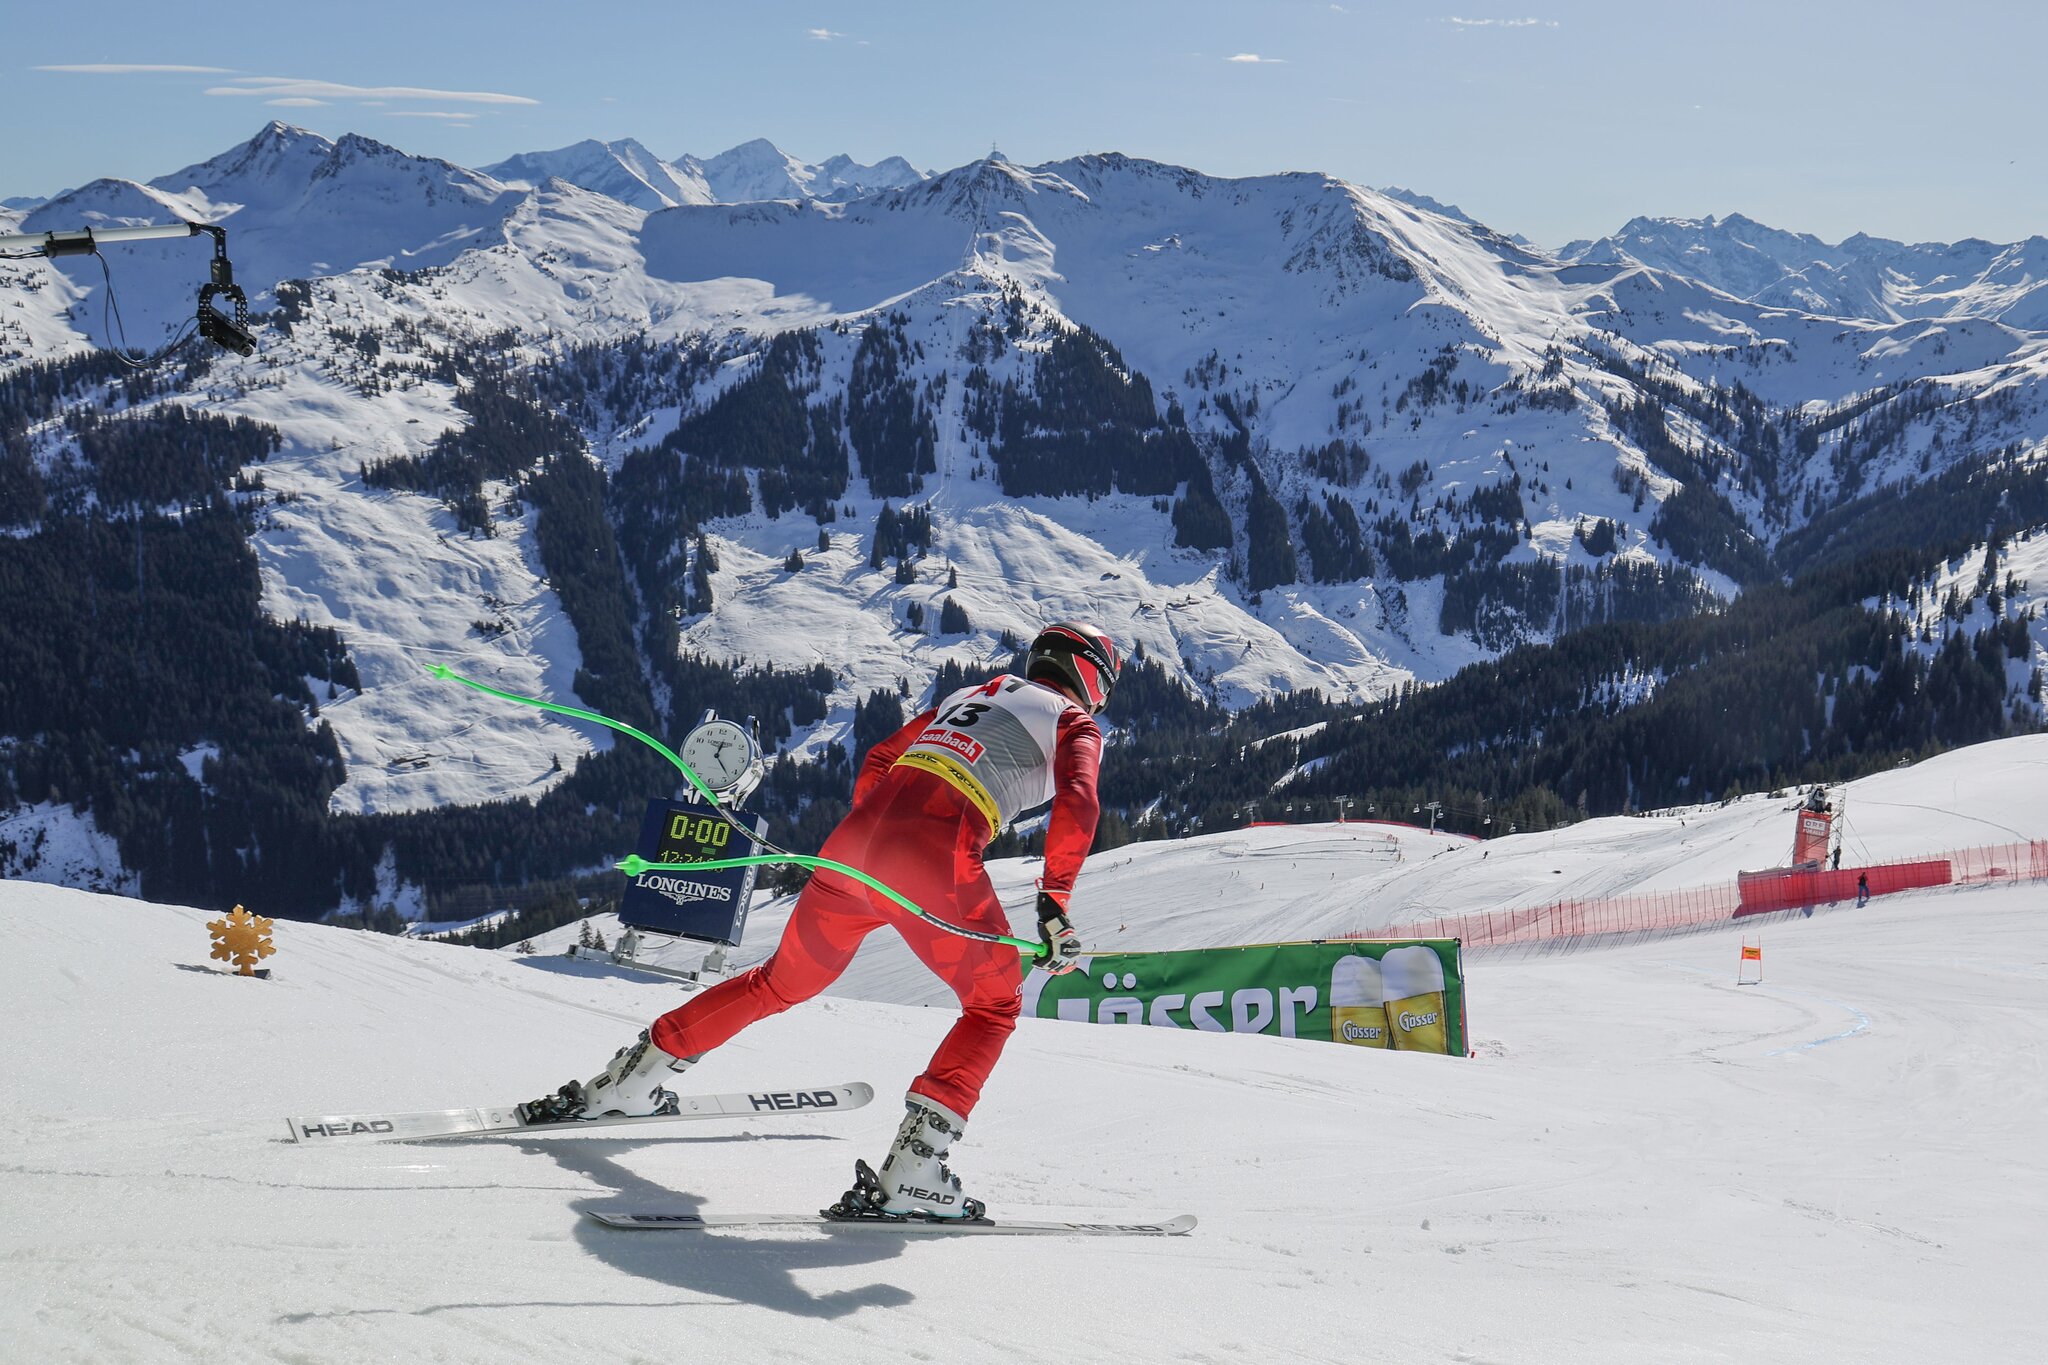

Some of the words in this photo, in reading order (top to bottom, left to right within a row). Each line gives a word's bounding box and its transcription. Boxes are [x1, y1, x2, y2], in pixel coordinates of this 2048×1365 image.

[934, 702, 992, 728] 13
[919, 729, 977, 758] saalbach
[670, 815, 730, 847] 0:00
[635, 873, 732, 902] LONGINES
[1342, 1020, 1381, 1042] Gösser
[1398, 1011, 1437, 1032] Gösser
[747, 1091, 838, 1111] HEAD
[301, 1120, 394, 1138] HEAD
[897, 1184, 955, 1205] HEAD
